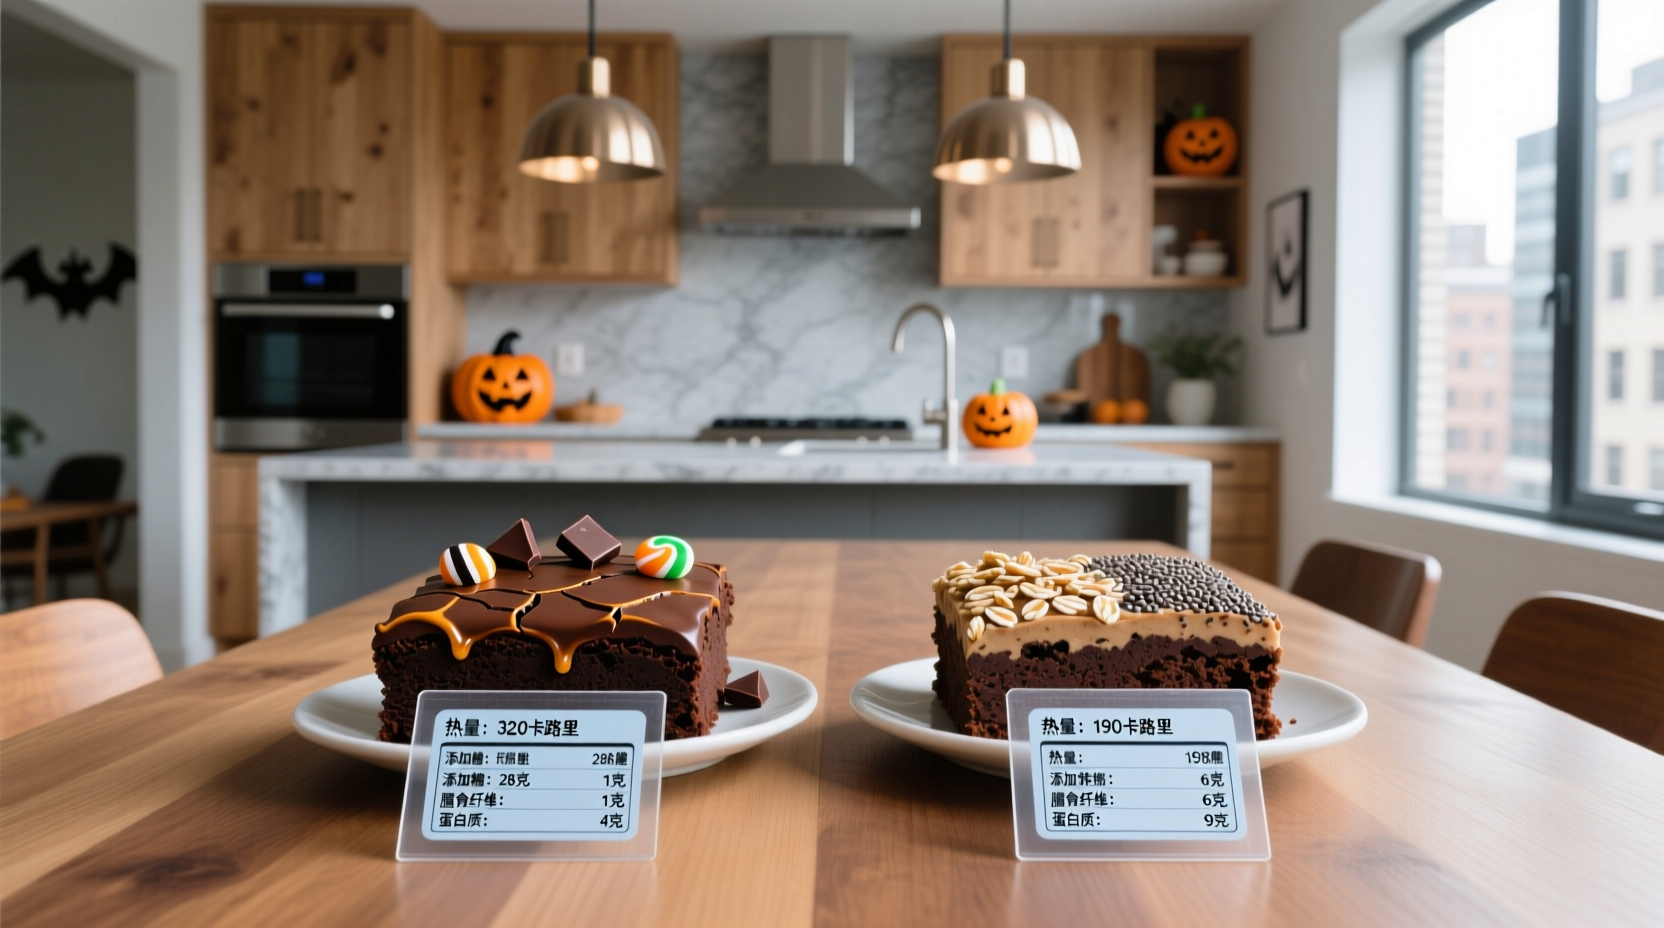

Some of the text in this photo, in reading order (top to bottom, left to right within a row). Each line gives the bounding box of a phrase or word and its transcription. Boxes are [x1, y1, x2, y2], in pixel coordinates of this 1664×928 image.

[603, 772, 626, 788] 1克
[1200, 771, 1225, 788] 6克
[602, 792, 625, 808] 1克
[1202, 793, 1228, 808] 6克
[600, 812, 623, 829] 4克
[1204, 812, 1230, 828] 9克
